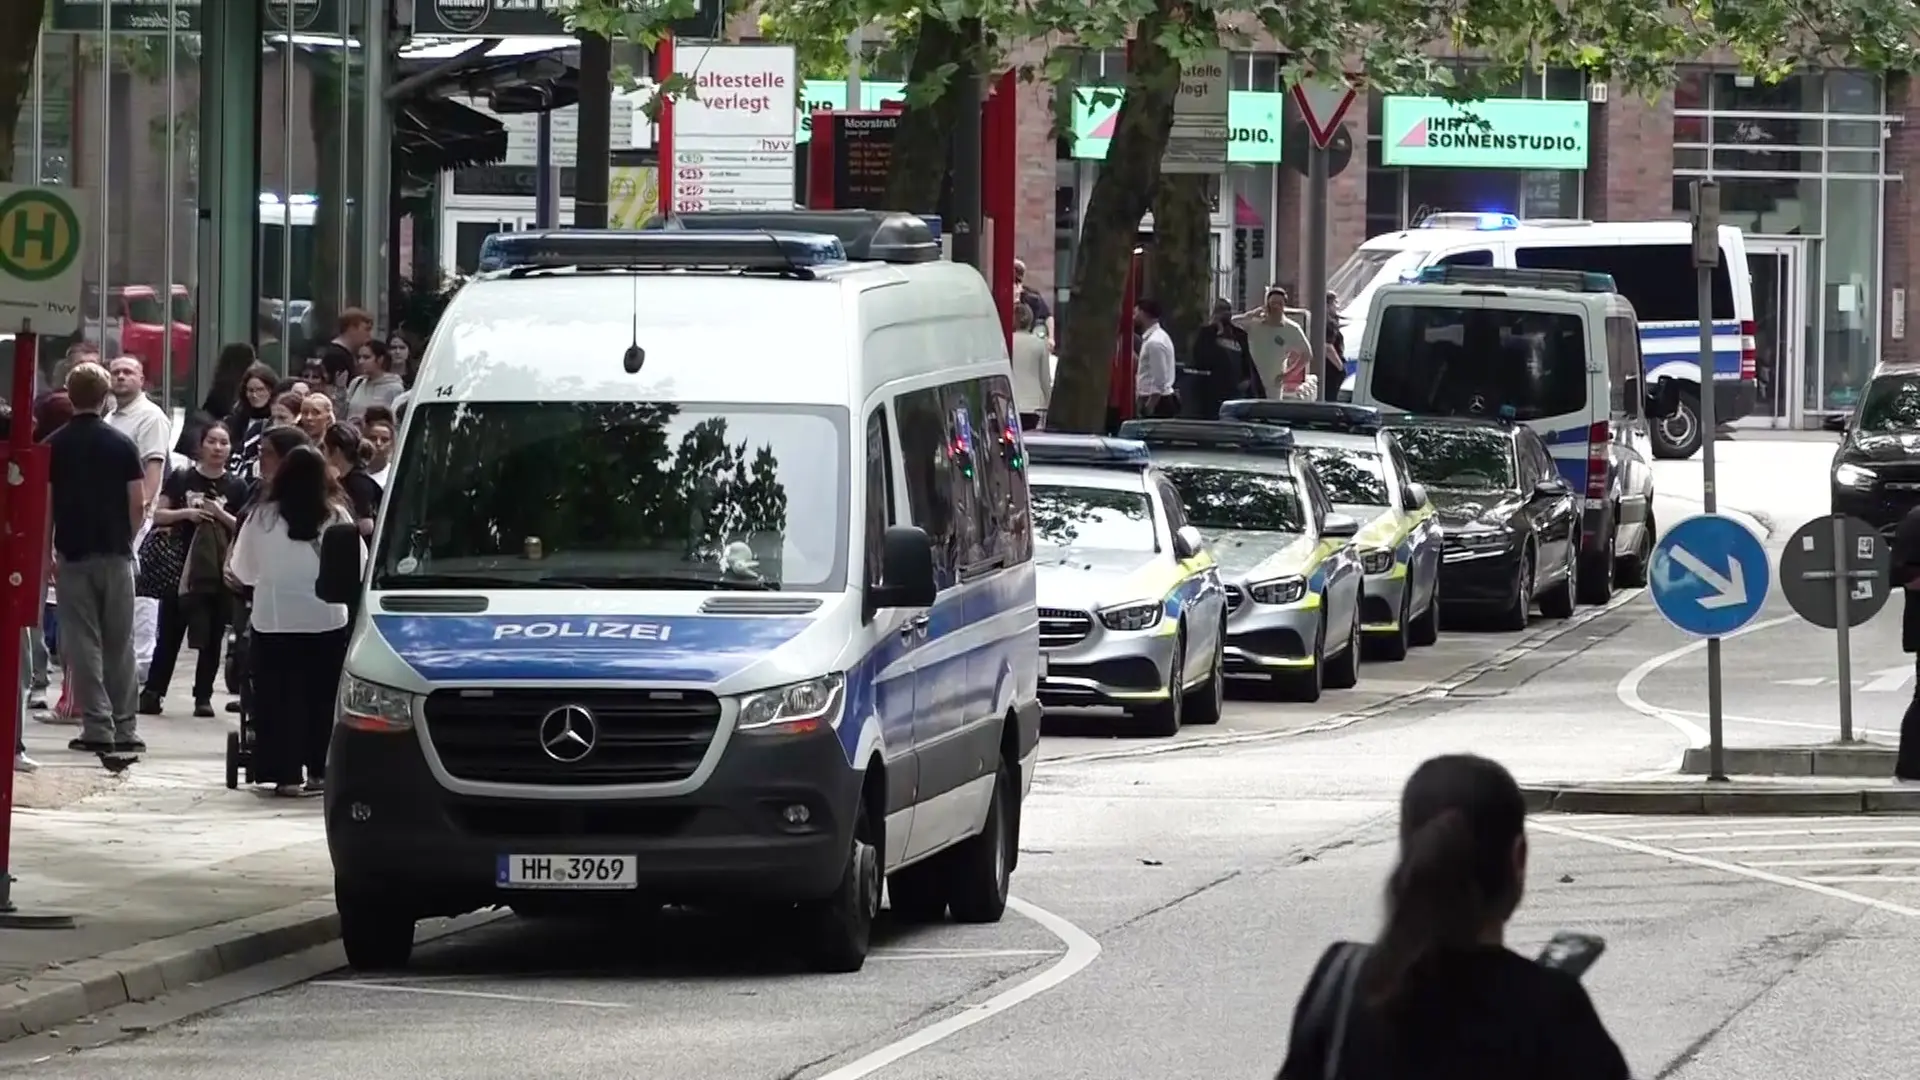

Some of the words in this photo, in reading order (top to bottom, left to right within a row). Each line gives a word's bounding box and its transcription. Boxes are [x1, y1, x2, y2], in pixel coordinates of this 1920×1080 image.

[698, 71, 785, 88] altestelle
[1181, 82, 1208, 97] legt
[703, 93, 770, 113] verlegt
[844, 118, 898, 128] Moorstraß
[762, 139, 790, 150] hvv
[1427, 134, 1581, 152] SONNENSTUDIO.
[12, 209, 57, 261] H
[435, 384, 454, 398] 14
[493, 622, 672, 641] POLIZEI
[522, 858, 551, 879] HH
[567, 858, 624, 880] 3969
